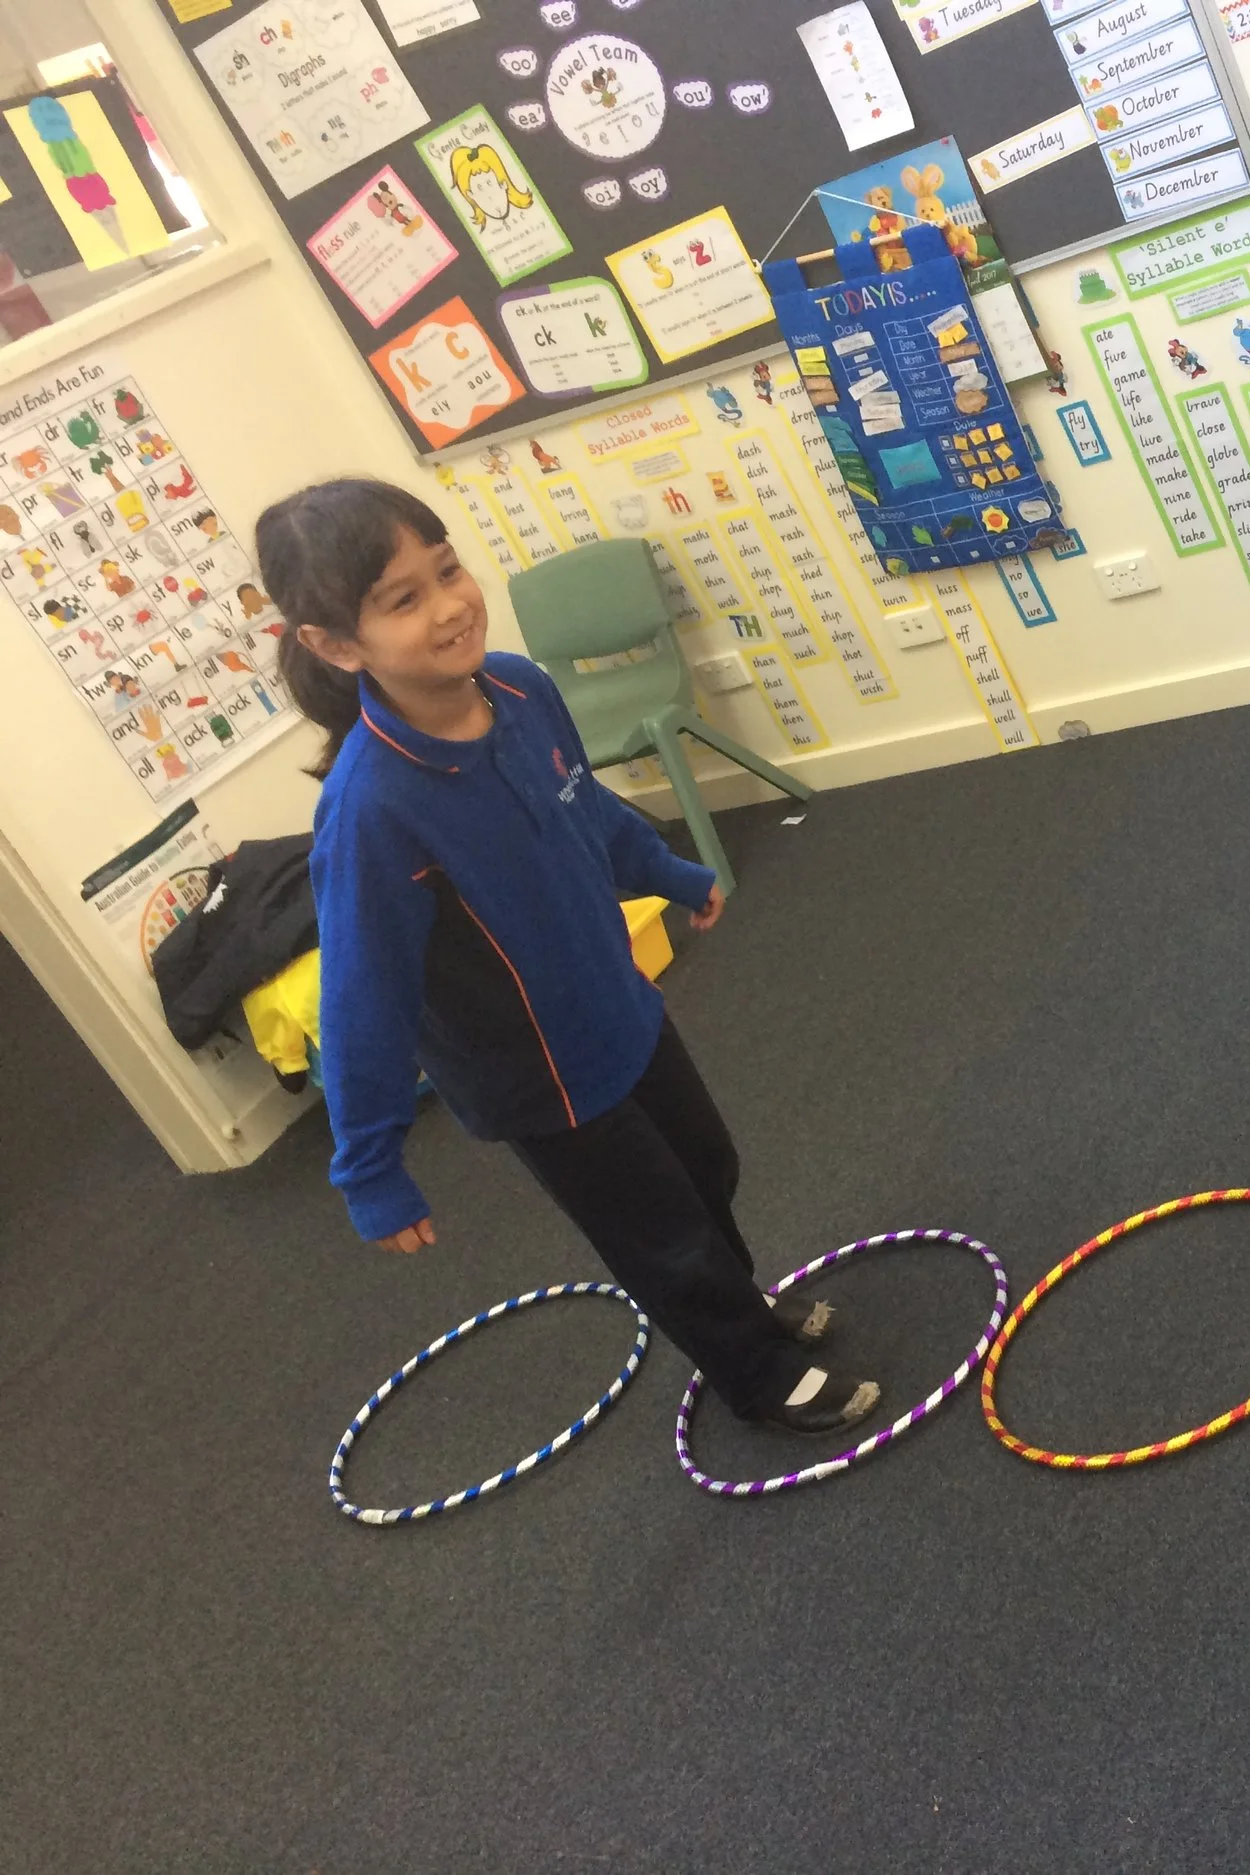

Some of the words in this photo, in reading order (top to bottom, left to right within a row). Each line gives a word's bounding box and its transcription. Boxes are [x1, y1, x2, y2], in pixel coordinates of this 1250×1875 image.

[1098, 3, 1147, 38] August
[233, 49, 250, 70] sh
[550, 50, 588, 96] Vowel
[588, 44, 638, 64] Team
[1097, 41, 1173, 83] September
[277, 54, 326, 88] Digraphs
[1122, 87, 1179, 116] October
[460, 121, 491, 141] Cindy
[1127, 122, 1203, 160] November
[999, 132, 1064, 168] Saturday
[1145, 169, 1218, 201] December
[1126, 252, 1205, 287] Syllable
[534, 325, 557, 347] ck
[1096, 330, 1113, 343] ate
[1104, 349, 1127, 371] five
[23, 386, 56, 412] Ends
[56, 376, 81, 397] Are
[79, 364, 104, 387] Fun
[1114, 369, 1146, 392] game
[1121, 390, 1142, 411] life
[1186, 397, 1221, 413] brave
[1068, 411, 1086, 433] fly
[1130, 412, 1153, 428] like
[1197, 422, 1226, 438] close
[1079, 439, 1099, 454] try
[1146, 446, 1179, 466] made
[1207, 446, 1240, 468] globe
[1155, 467, 1188, 485] make
[1164, 491, 1191, 505] nine
[1181, 528, 1206, 544] take
[1009, 572, 1022, 581] no
[1018, 591, 1028, 600] so
[1027, 608, 1042, 617] we
[158, 689, 182, 712] ing
[227, 694, 252, 715] ock
[184, 723, 209, 748] ack
